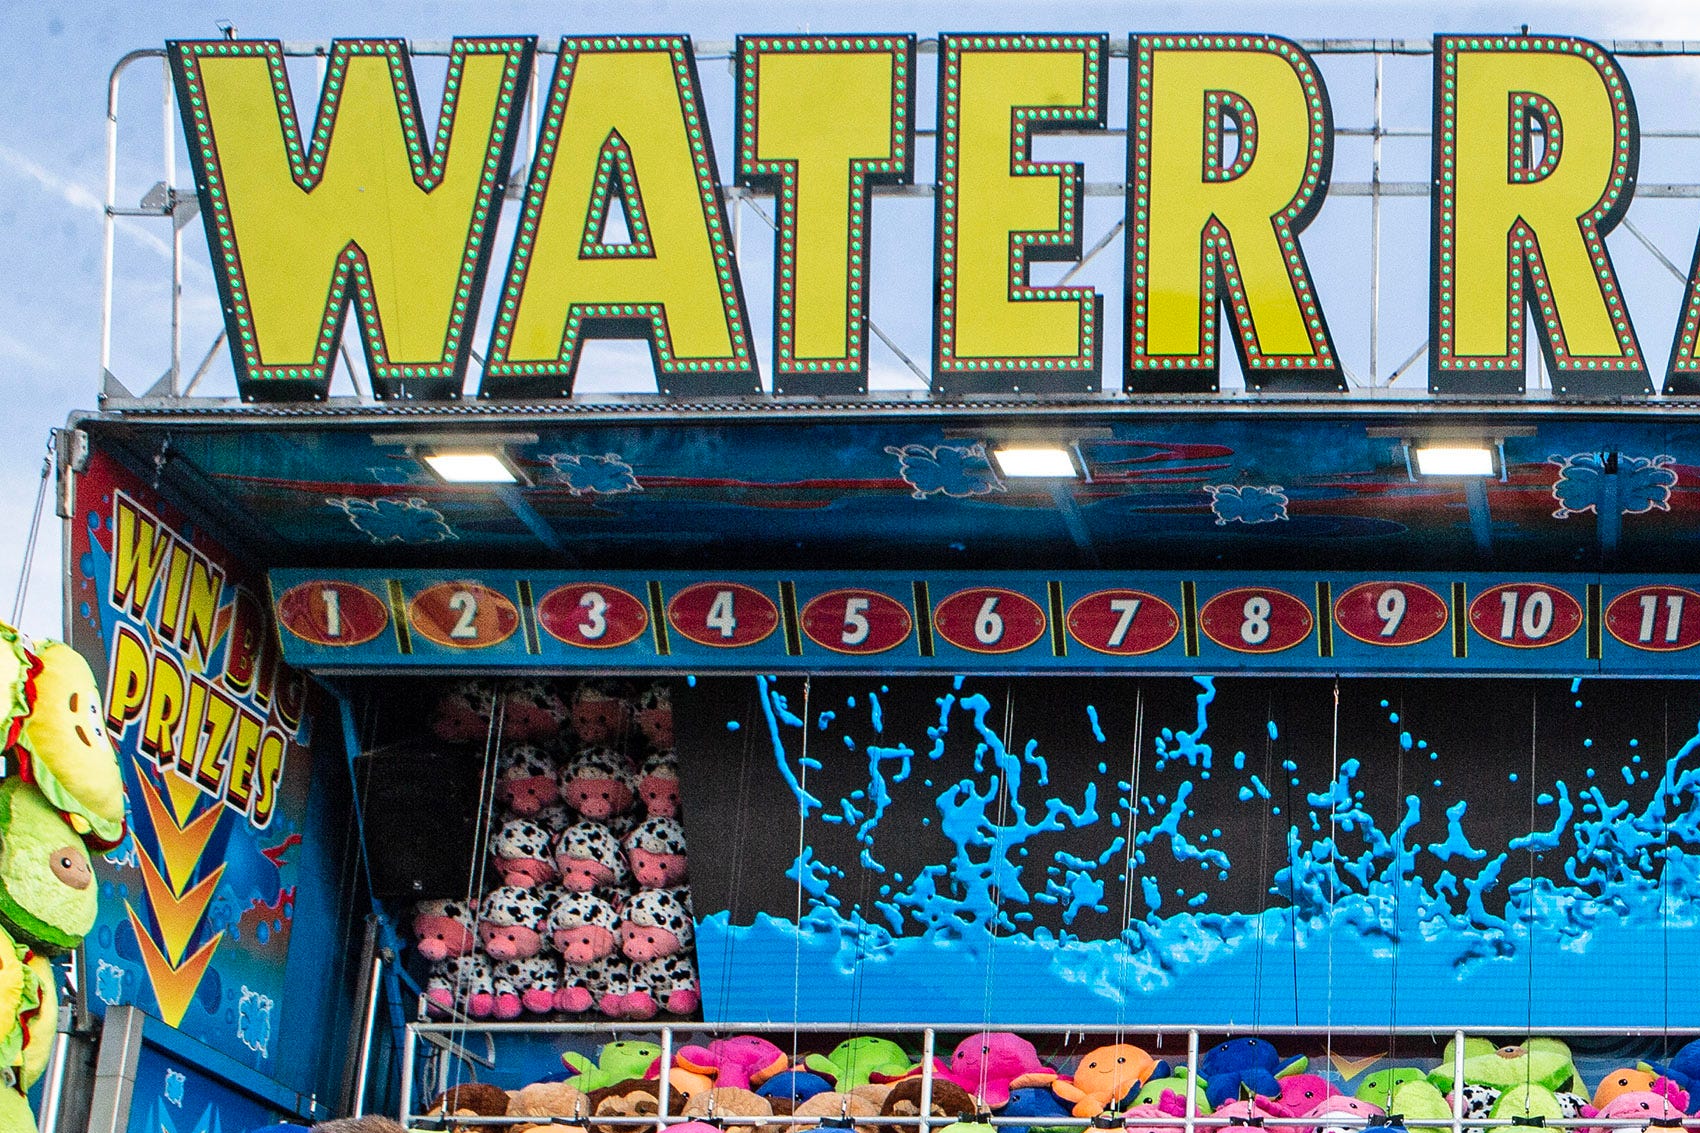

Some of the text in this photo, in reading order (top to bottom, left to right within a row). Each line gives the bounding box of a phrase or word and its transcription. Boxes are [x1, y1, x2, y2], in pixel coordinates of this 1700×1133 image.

[166, 32, 1348, 401] WATER
[112, 492, 223, 668] WIN
[321, 590, 340, 637] 1
[448, 591, 477, 639] 2
[577, 591, 610, 640] 3
[705, 591, 736, 638] 4
[840, 598, 869, 646] 5
[973, 597, 1003, 645] 6
[1106, 599, 1140, 647] 7
[1239, 596, 1271, 645] 8
[1375, 588, 1406, 637] 9
[1499, 591, 1553, 640] 10
[1638, 595, 1683, 642] 11
[106, 622, 287, 830] PRIZES
